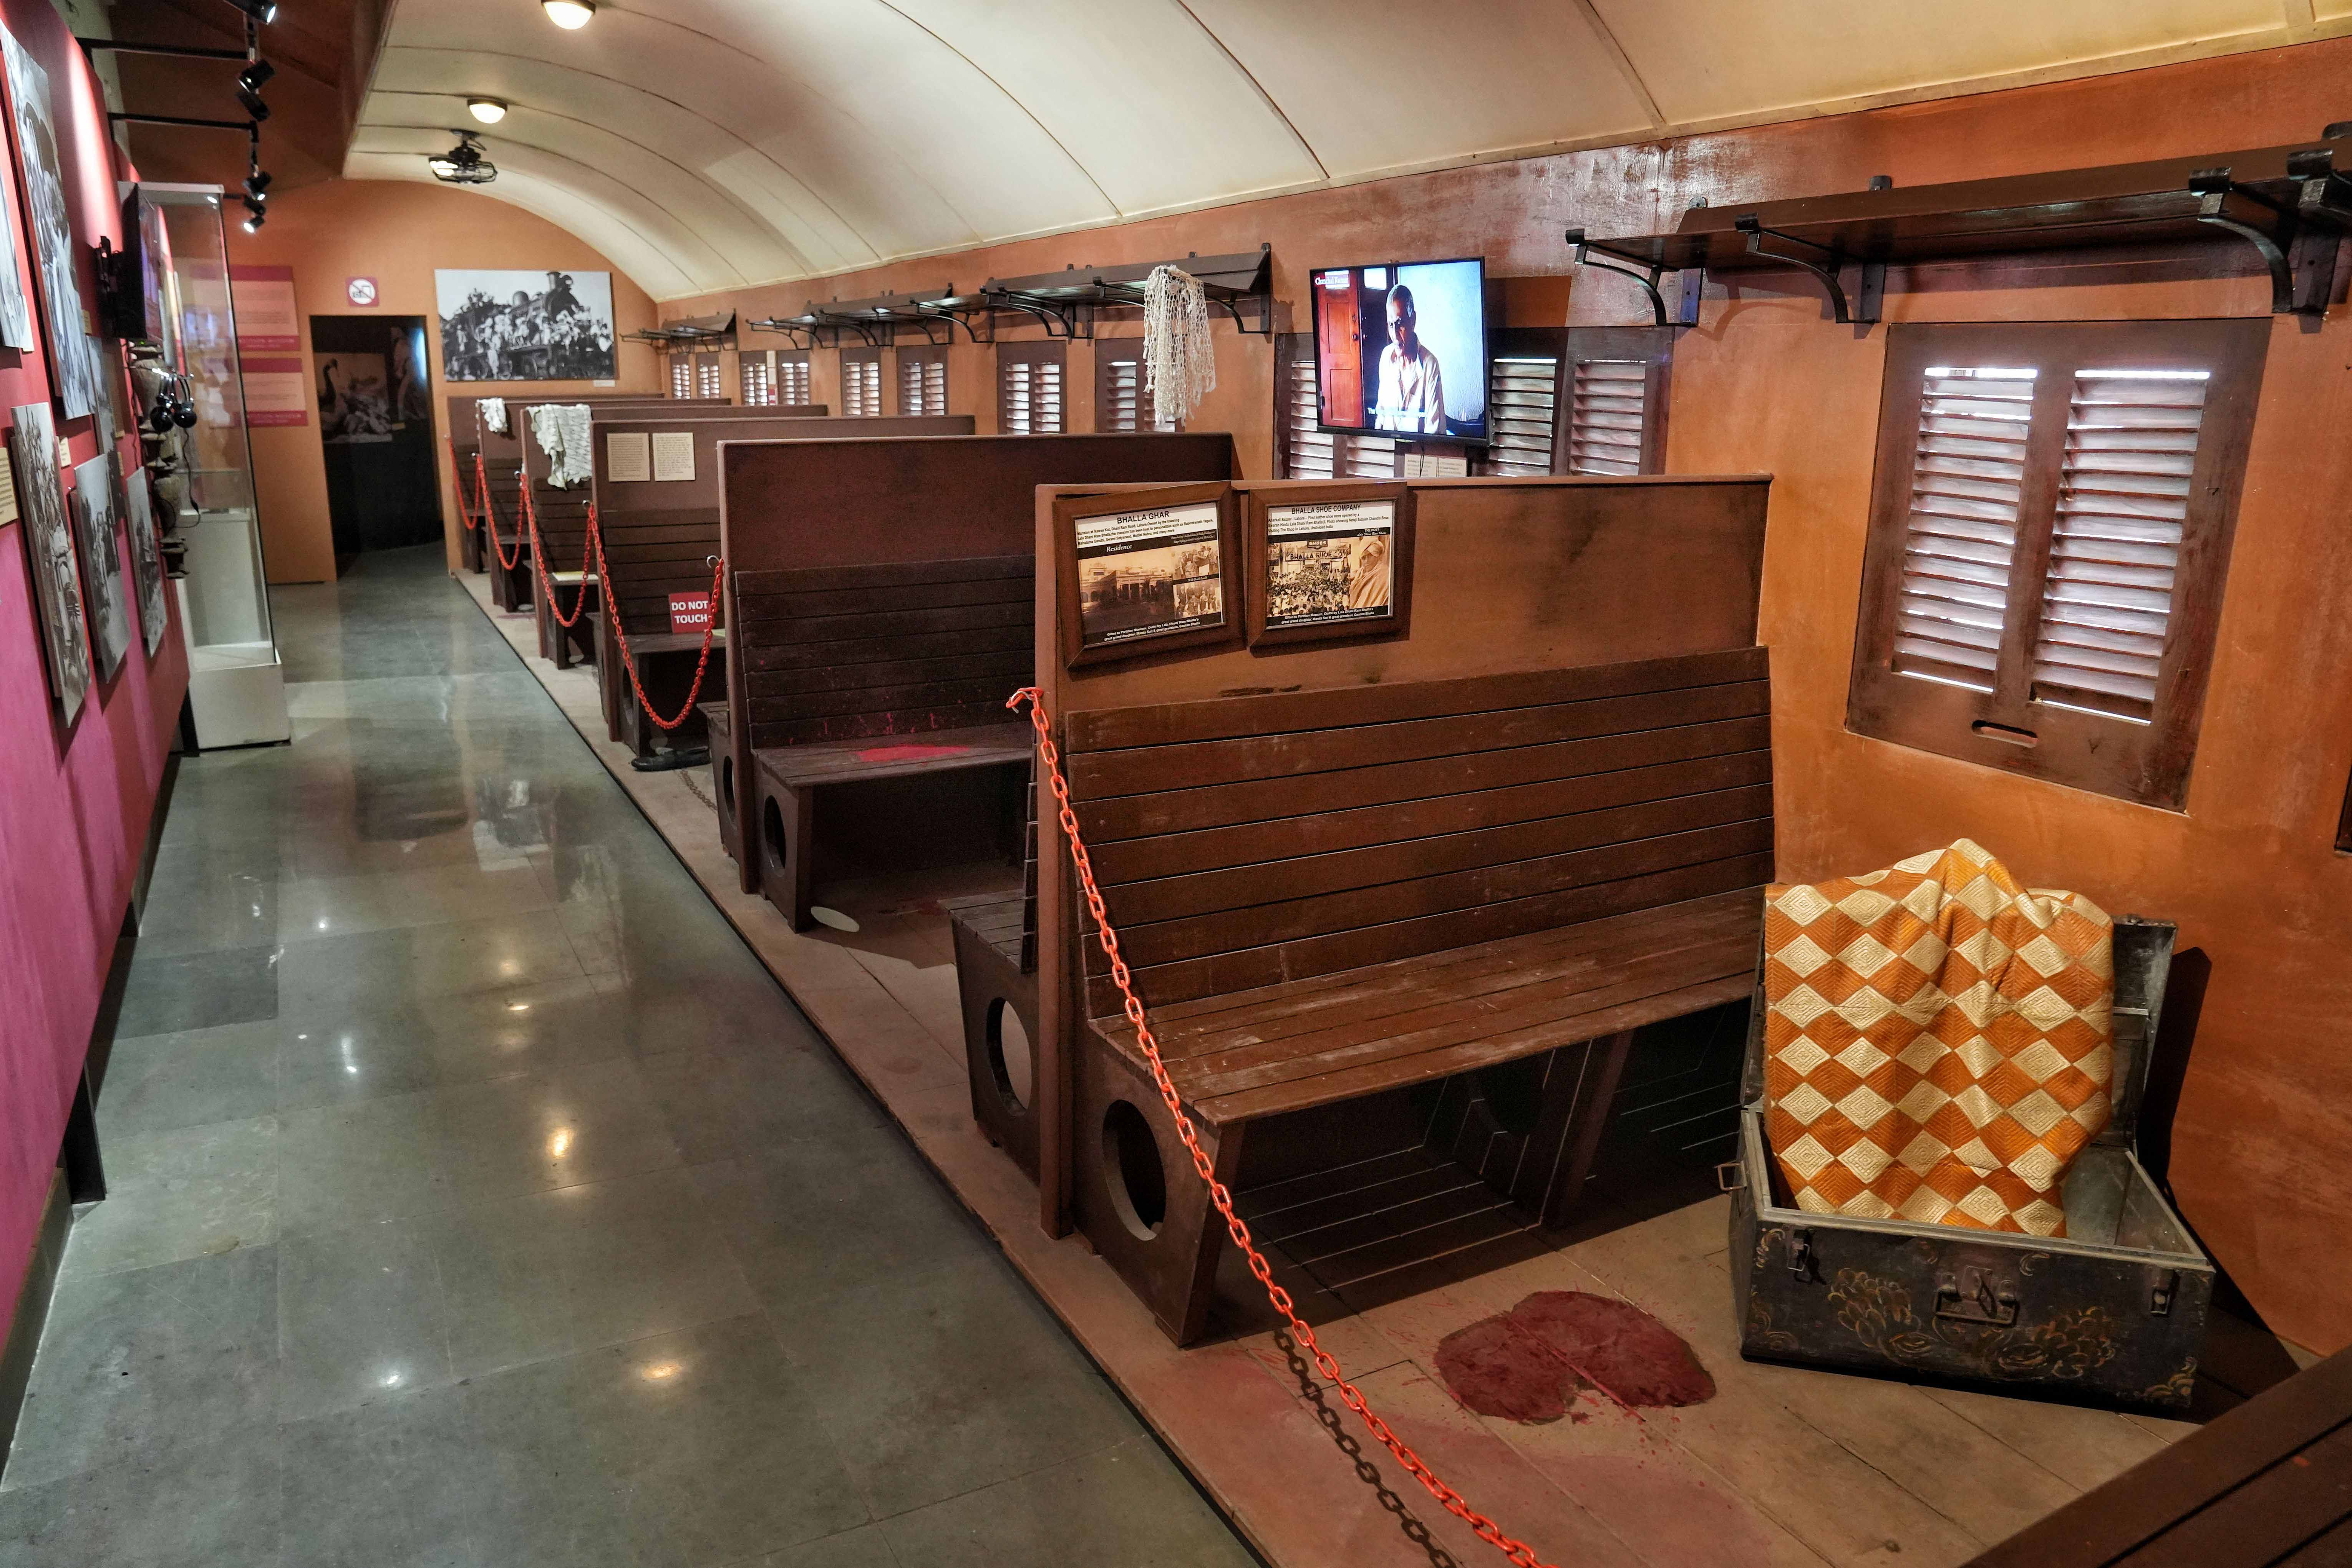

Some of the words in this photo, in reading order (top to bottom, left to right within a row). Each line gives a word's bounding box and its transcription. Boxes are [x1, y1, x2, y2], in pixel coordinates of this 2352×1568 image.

[1117, 514, 1147, 524] BHALLA
[1149, 511, 1169, 519] GHAR
[1106, 543, 1132, 552] Residence
[671, 602, 686, 611] DO
[688, 600, 708, 610] NOT
[674, 613, 707, 624] TOUCH
